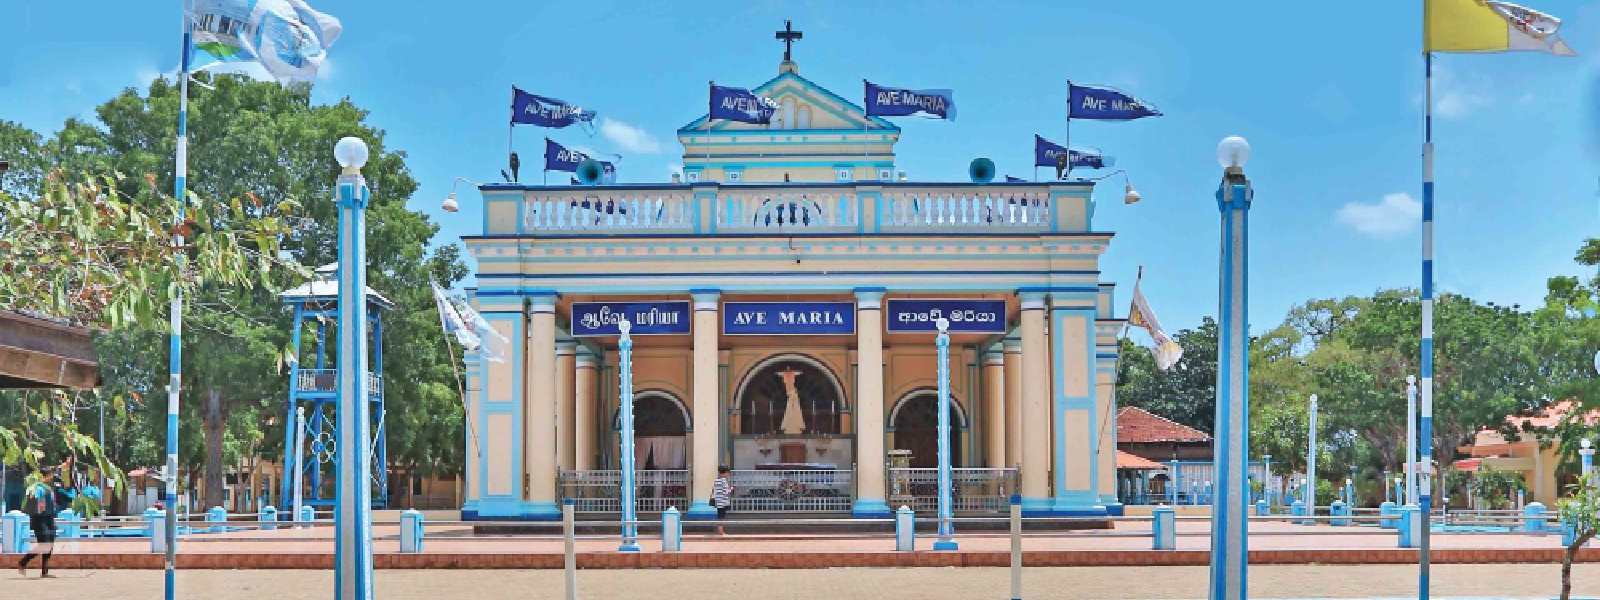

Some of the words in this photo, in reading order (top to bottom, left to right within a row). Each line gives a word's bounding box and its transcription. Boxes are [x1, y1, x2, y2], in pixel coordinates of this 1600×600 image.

[721, 96, 747, 111] AVE
[876, 90, 902, 106] AVE
[903, 91, 945, 111] MARIA
[1082, 95, 1107, 111] AVE
[556, 149, 579, 163] AVE
[636, 307, 680, 326] மரியா
[733, 311, 767, 325] AVE
[778, 311, 844, 325] MARIA
